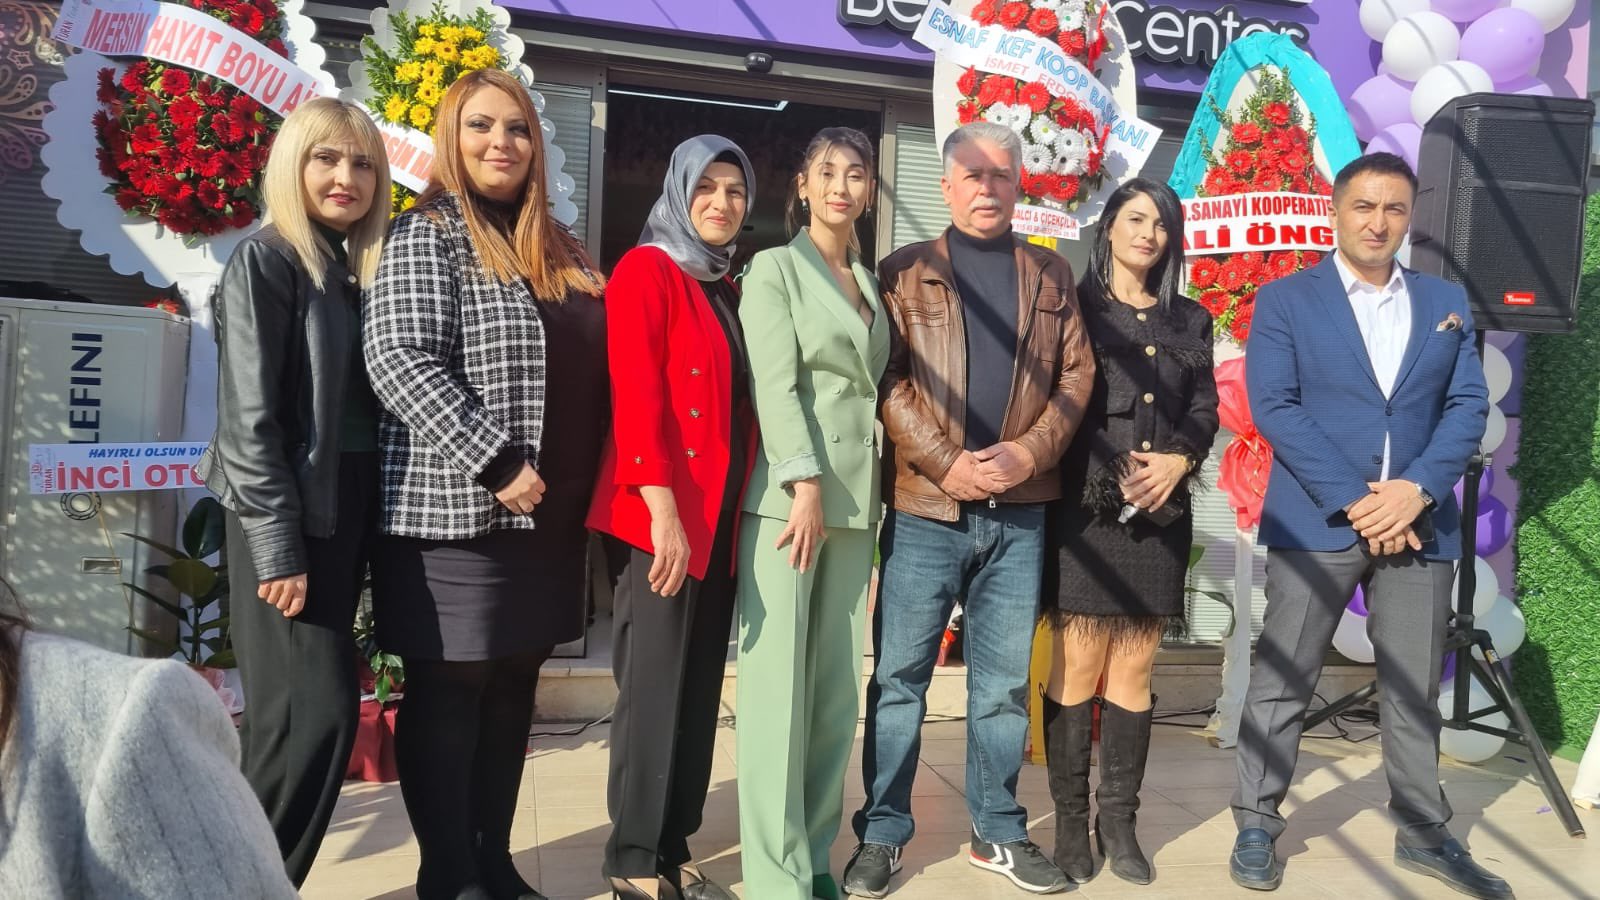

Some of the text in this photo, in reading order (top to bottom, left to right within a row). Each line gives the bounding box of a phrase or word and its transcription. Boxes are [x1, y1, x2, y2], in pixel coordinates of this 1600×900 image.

[82, 3, 151, 53] MERSİN
[143, 15, 223, 68] HAYAT
[216, 41, 288, 105] BOYU
[928, 7, 989, 48] ESNAF
[994, 33, 1036, 60] KEF
[1035, 46, 1089, 91] KOOP
[57, 460, 131, 491] İNCİ
[89, 448, 142, 458] HAYIRLI
[145, 447, 186, 457] OLSUN
